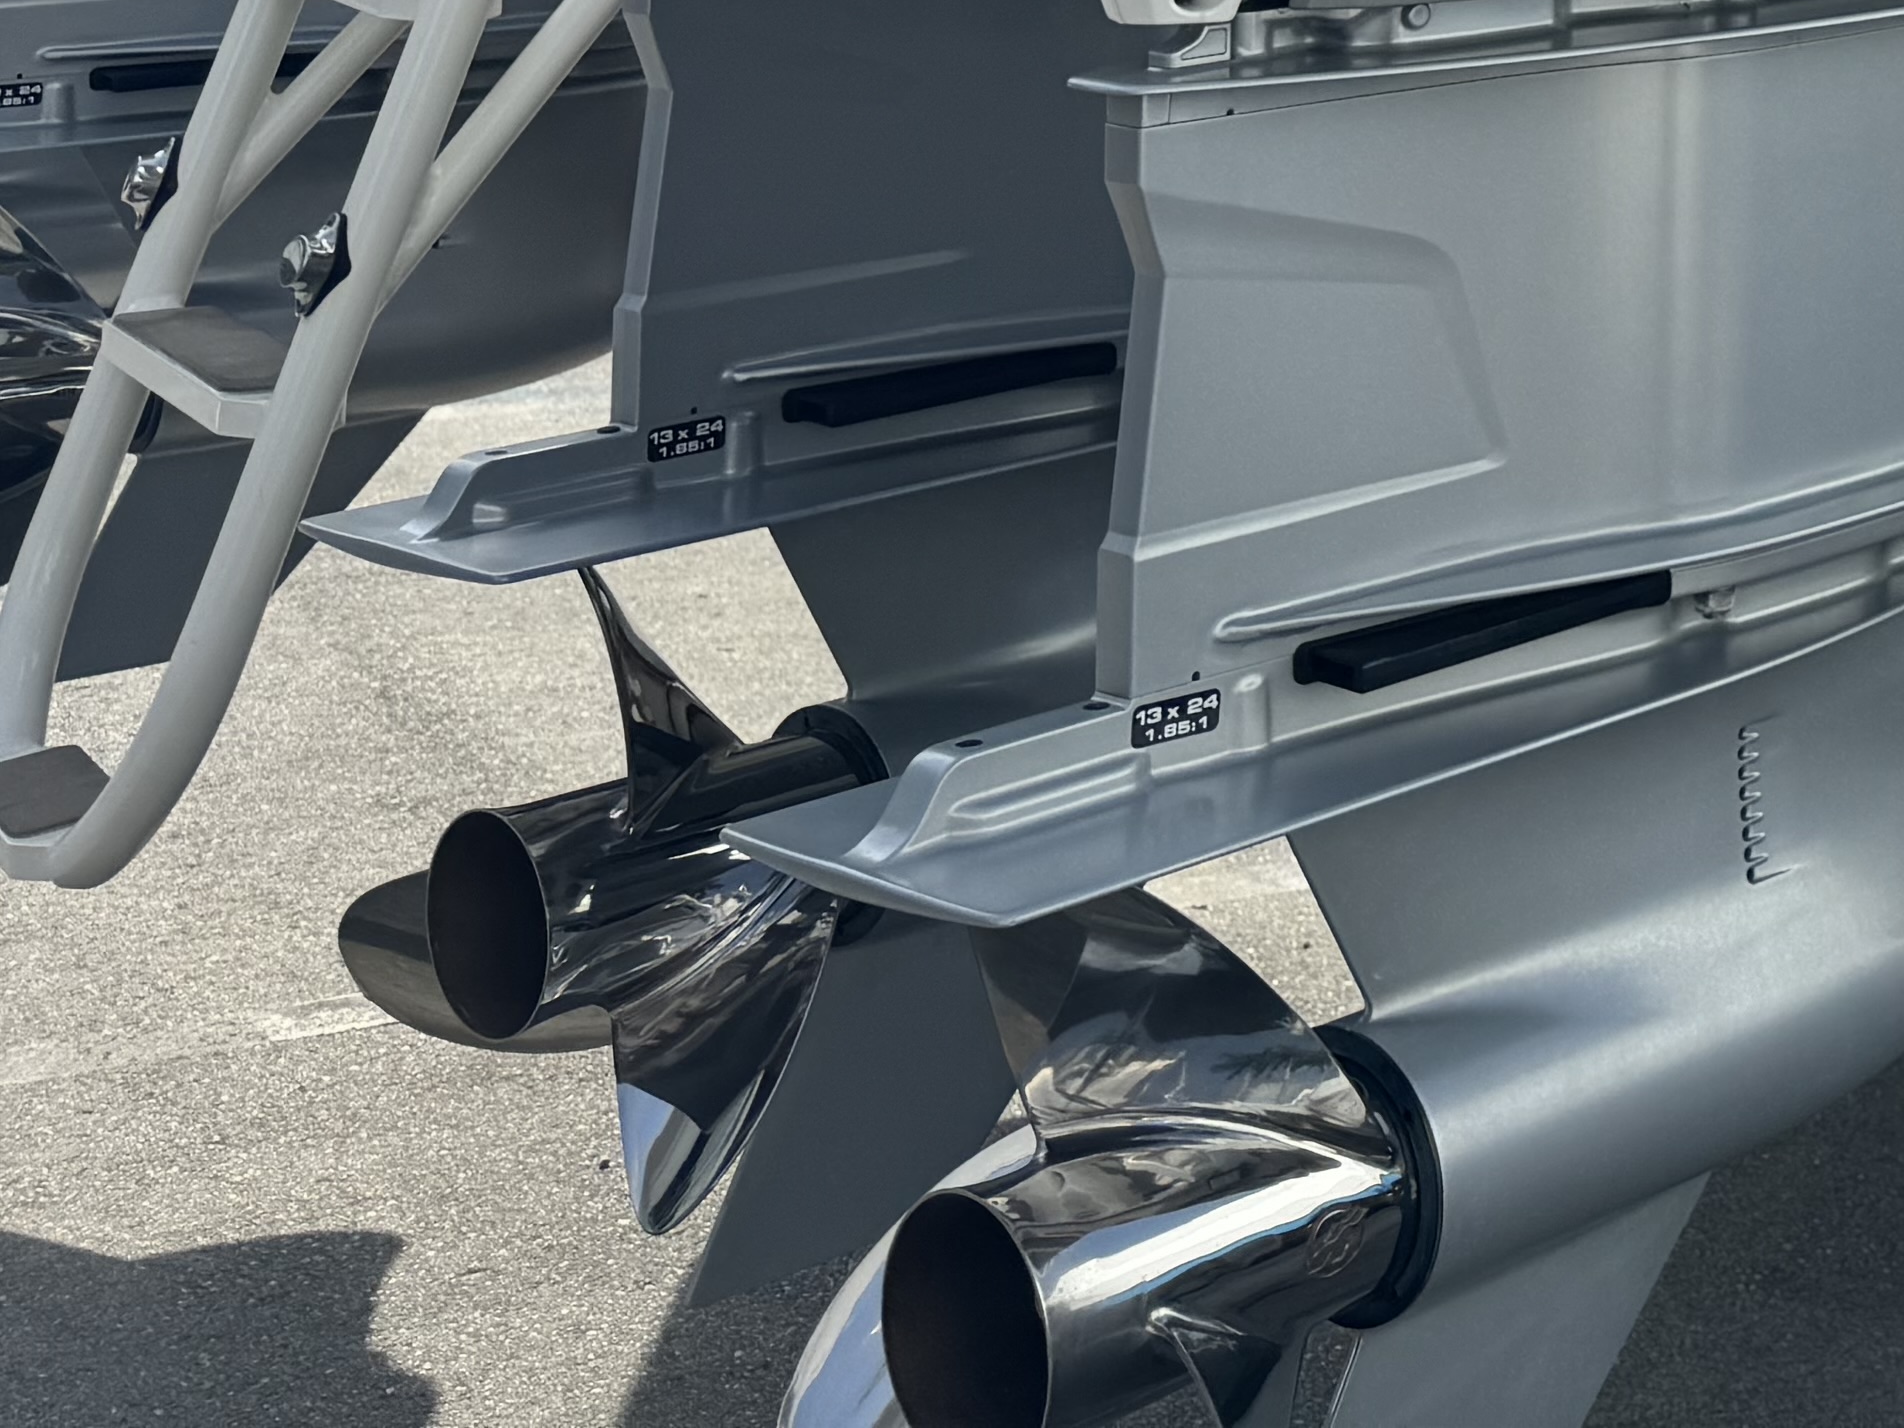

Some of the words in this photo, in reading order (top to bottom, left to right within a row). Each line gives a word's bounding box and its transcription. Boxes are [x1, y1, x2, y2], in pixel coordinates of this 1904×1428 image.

[649, 430, 673, 445] 13
[696, 419, 724, 436] 24
[659, 437, 715, 458] 1.85:1
[1135, 706, 1162, 726] 13
[1167, 706, 1179, 720] x
[1187, 693, 1219, 714] 24
[1145, 715, 1208, 742] 1.85:1
